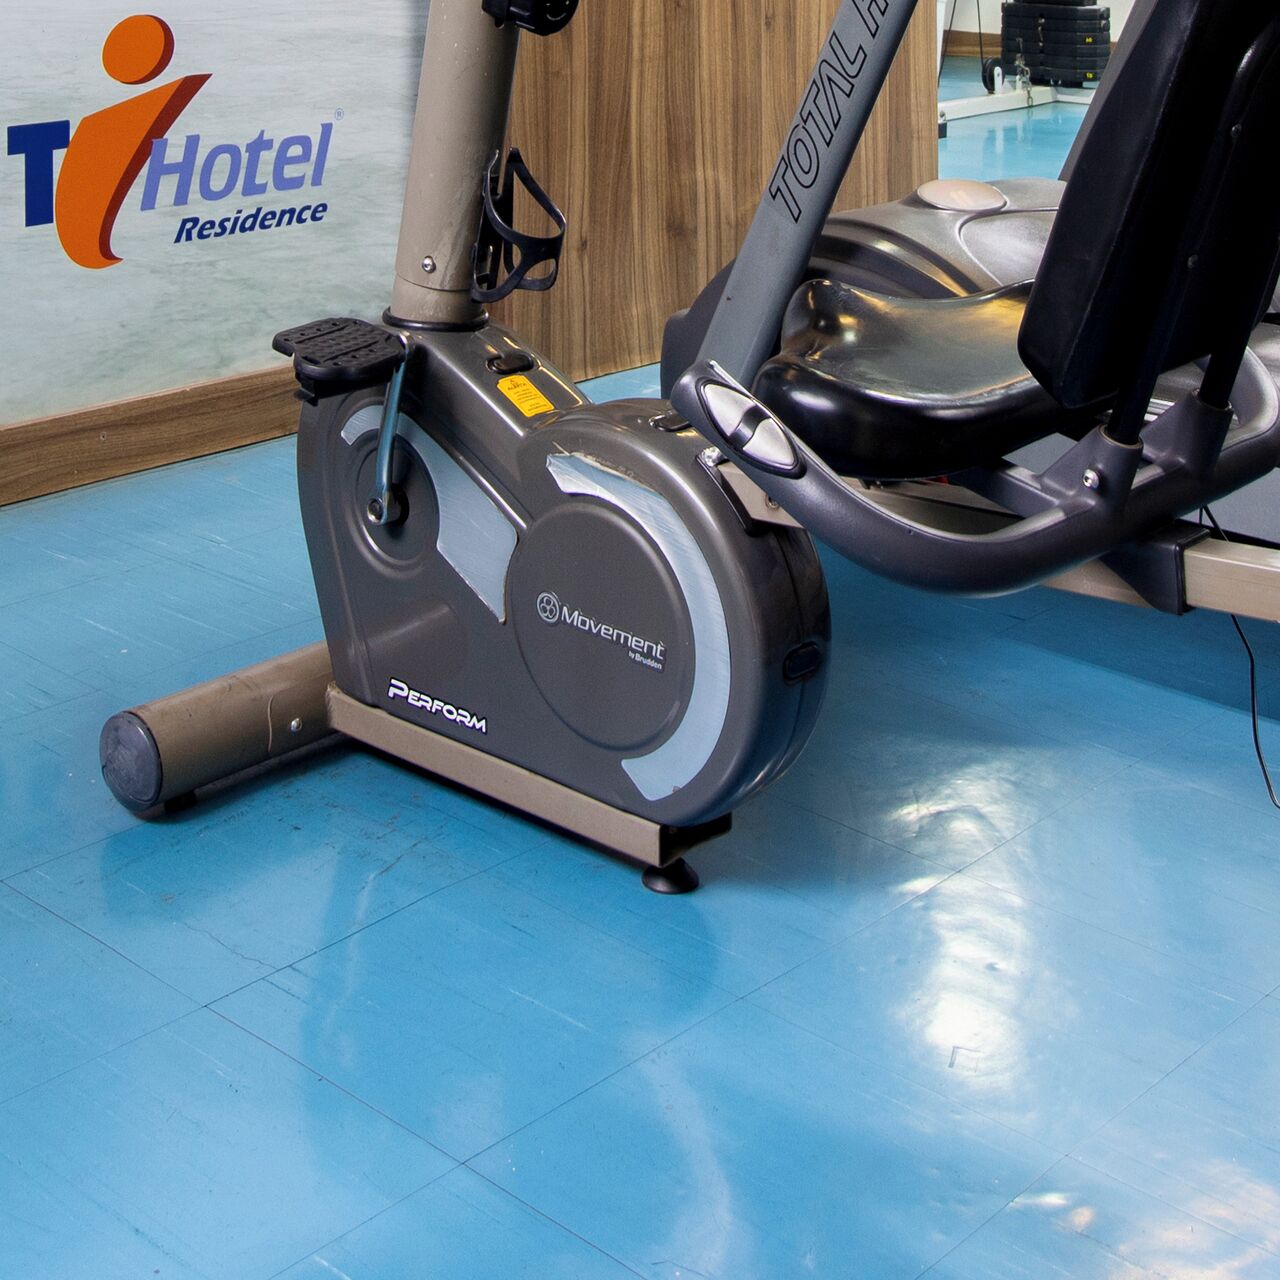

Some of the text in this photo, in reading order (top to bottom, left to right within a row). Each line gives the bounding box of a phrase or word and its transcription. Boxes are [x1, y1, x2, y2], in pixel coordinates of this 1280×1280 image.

[769, 30, 867, 224] TOTAL
[139, 122, 333, 213] Hotel
[173, 202, 328, 244] Residence
[561, 604, 666, 660] Movement
[387, 676, 488, 734] PERFORM
